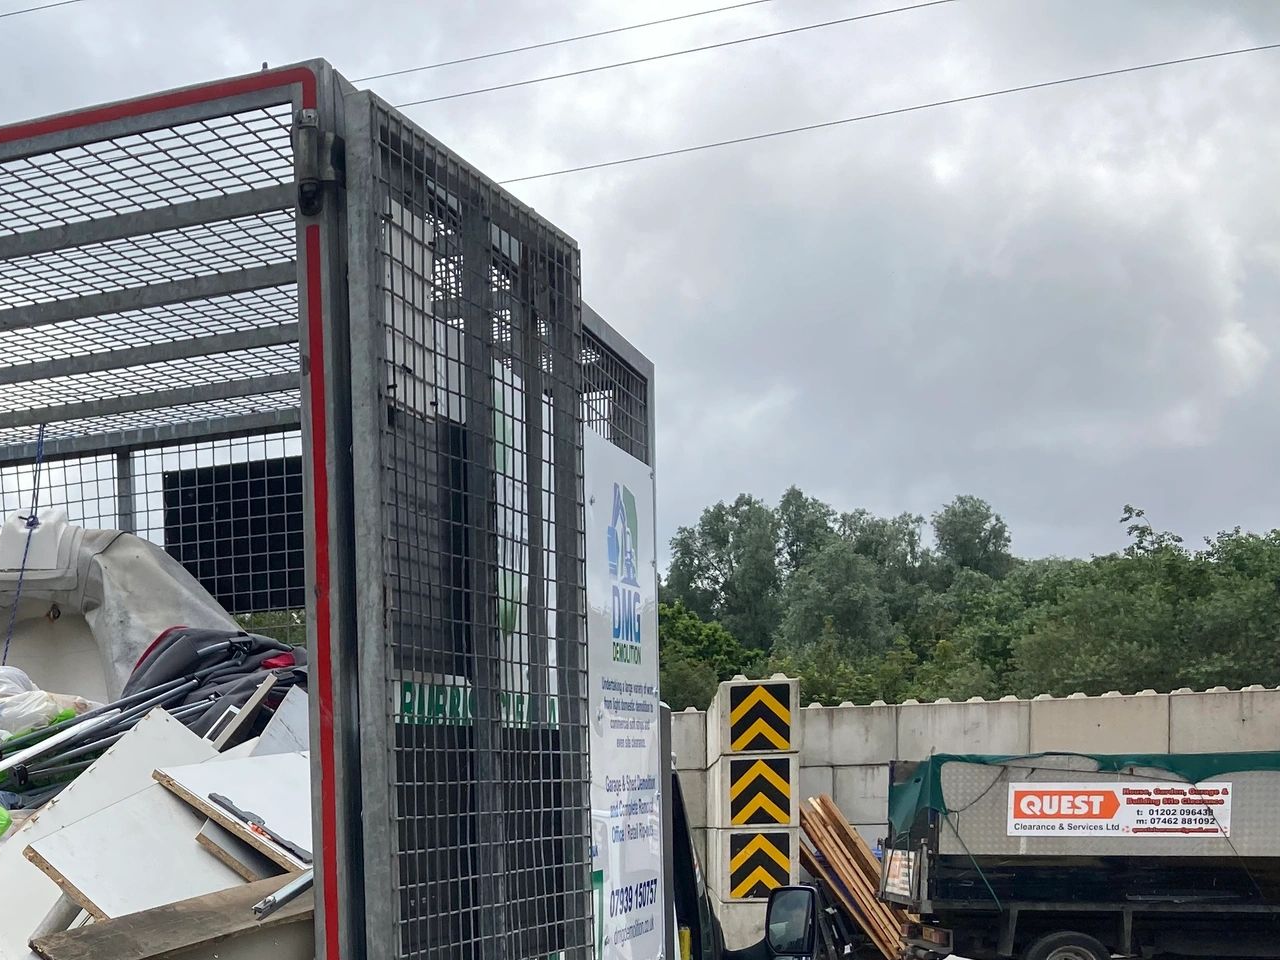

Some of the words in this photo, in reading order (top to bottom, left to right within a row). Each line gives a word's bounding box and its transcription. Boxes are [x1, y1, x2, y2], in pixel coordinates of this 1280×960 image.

[612, 586, 640, 643] DMG
[613, 641, 641, 665] DEMOLITION
[606, 775, 621, 796] Garage
[622, 775, 625, 791] &
[626, 774, 637, 791] Shed
[637, 774, 655, 790] Demolition
[619, 800, 638, 819] Complete
[1020, 795, 1104, 815] QUEST
[1014, 823, 1056, 831] Clearance
[1058, 823, 1064, 831] &
[1067, 822, 1104, 831] Services
[1106, 823, 1120, 831] Ltd
[1150, 817, 1178, 825] 07462
[1181, 817, 1215, 825] 881092
[612, 825, 624, 843] Office
[627, 823, 638, 840] Retail
[610, 886, 633, 918] 07939
[634, 878, 657, 909] 150757
